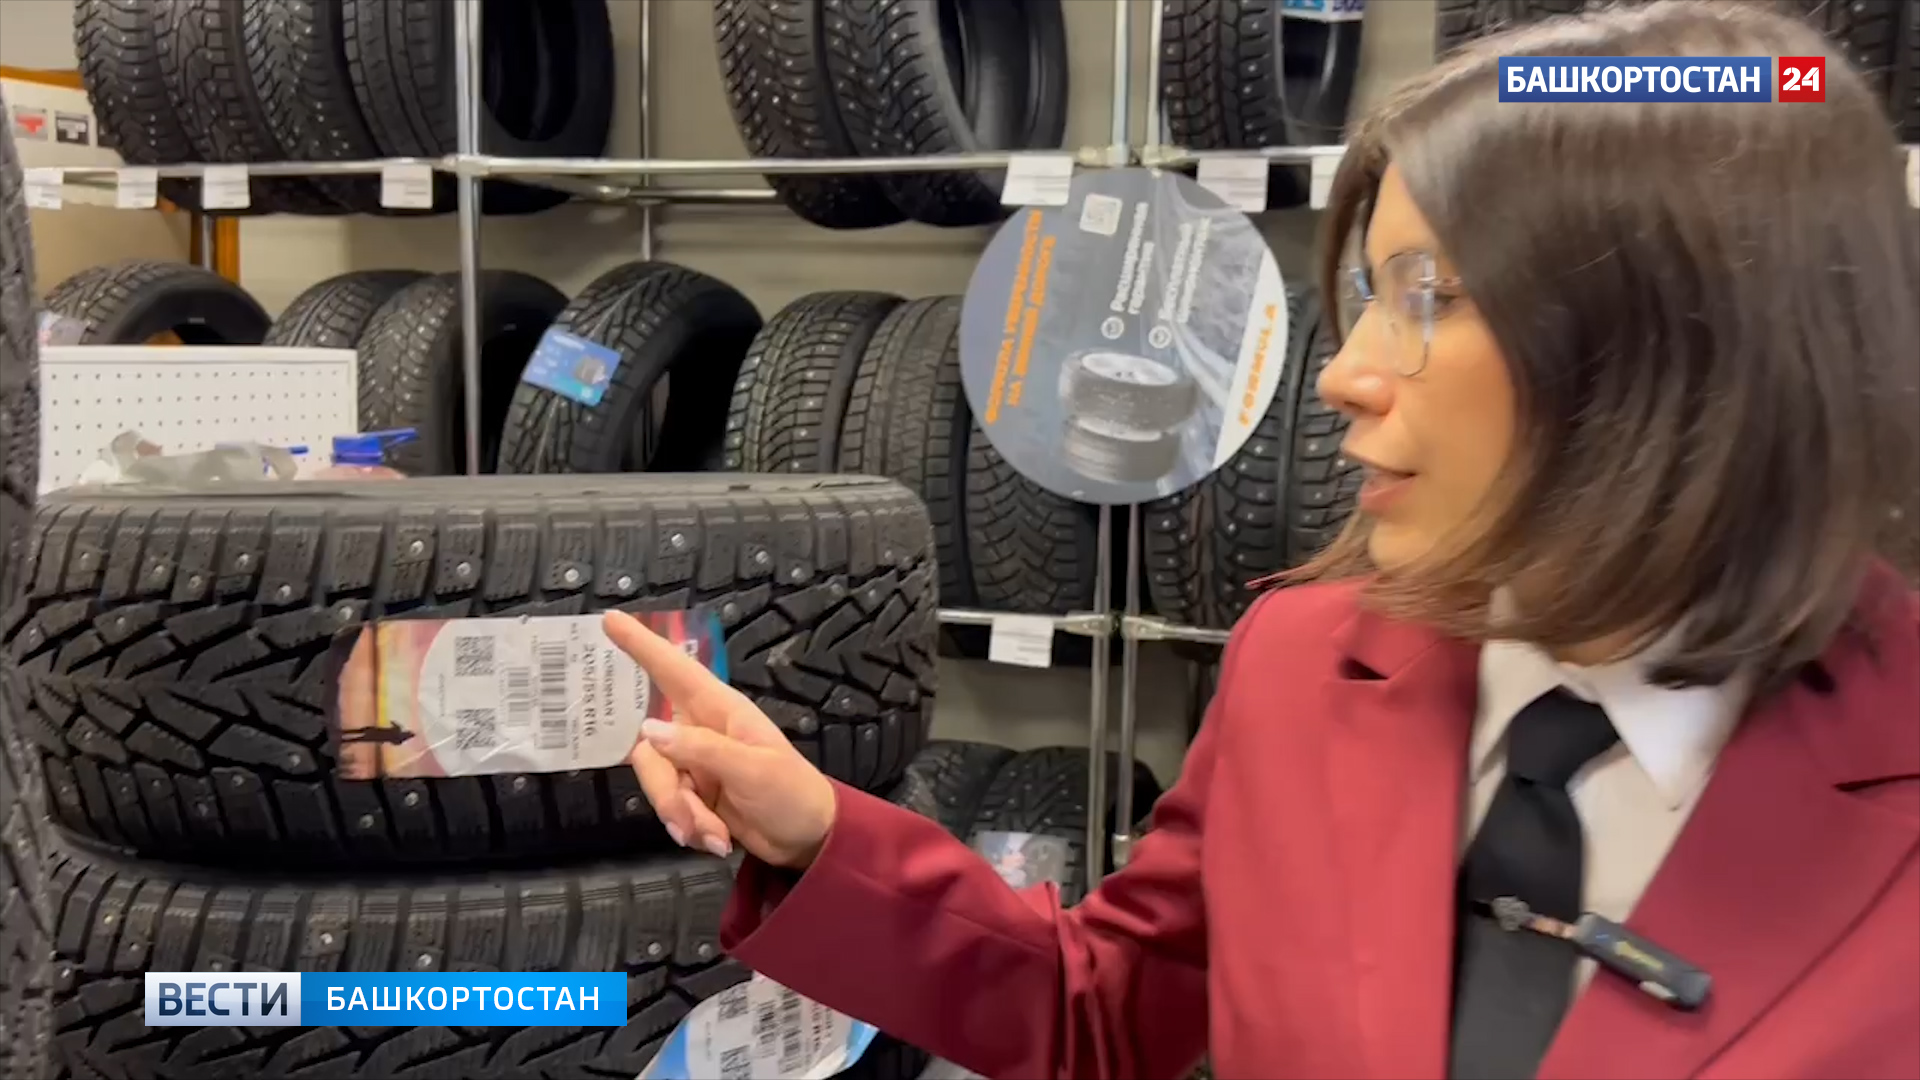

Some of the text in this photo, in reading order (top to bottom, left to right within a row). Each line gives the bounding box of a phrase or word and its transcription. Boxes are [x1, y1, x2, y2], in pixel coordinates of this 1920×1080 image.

[1239, 304, 1277, 425] FORMULA
[582, 643, 597, 738] 205/55 R16
